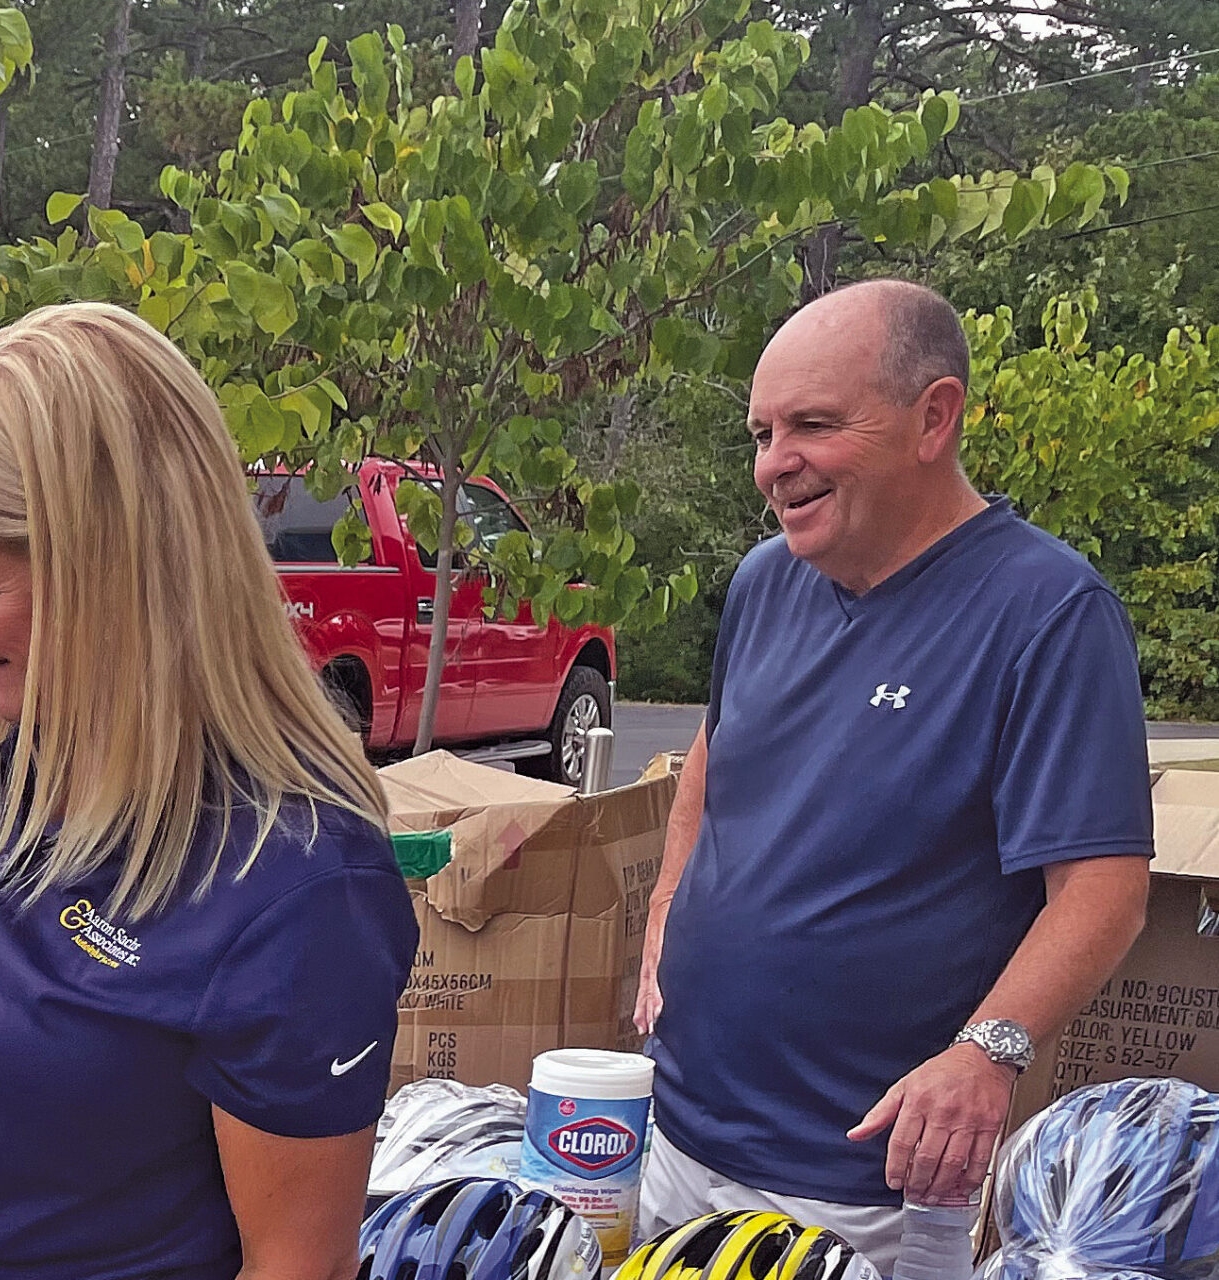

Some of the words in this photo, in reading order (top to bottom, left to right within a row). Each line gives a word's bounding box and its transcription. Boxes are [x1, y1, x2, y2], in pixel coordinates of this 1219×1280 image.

[284, 601, 314, 619] X4
[82, 908, 116, 937] Aaron
[112, 928, 142, 952] Sachs
[1079, 999, 1194, 1028] EASUREMENT:
[428, 1031, 457, 1049] PCS
[1121, 1026, 1197, 1051] YELLOW
[427, 1050, 457, 1067] KGS
[1058, 1039, 1100, 1062] SIZE:
[1104, 1045, 1117, 1063] S
[1120, 1047, 1180, 1070] 52-57
[558, 1130, 631, 1155] CLOROX
